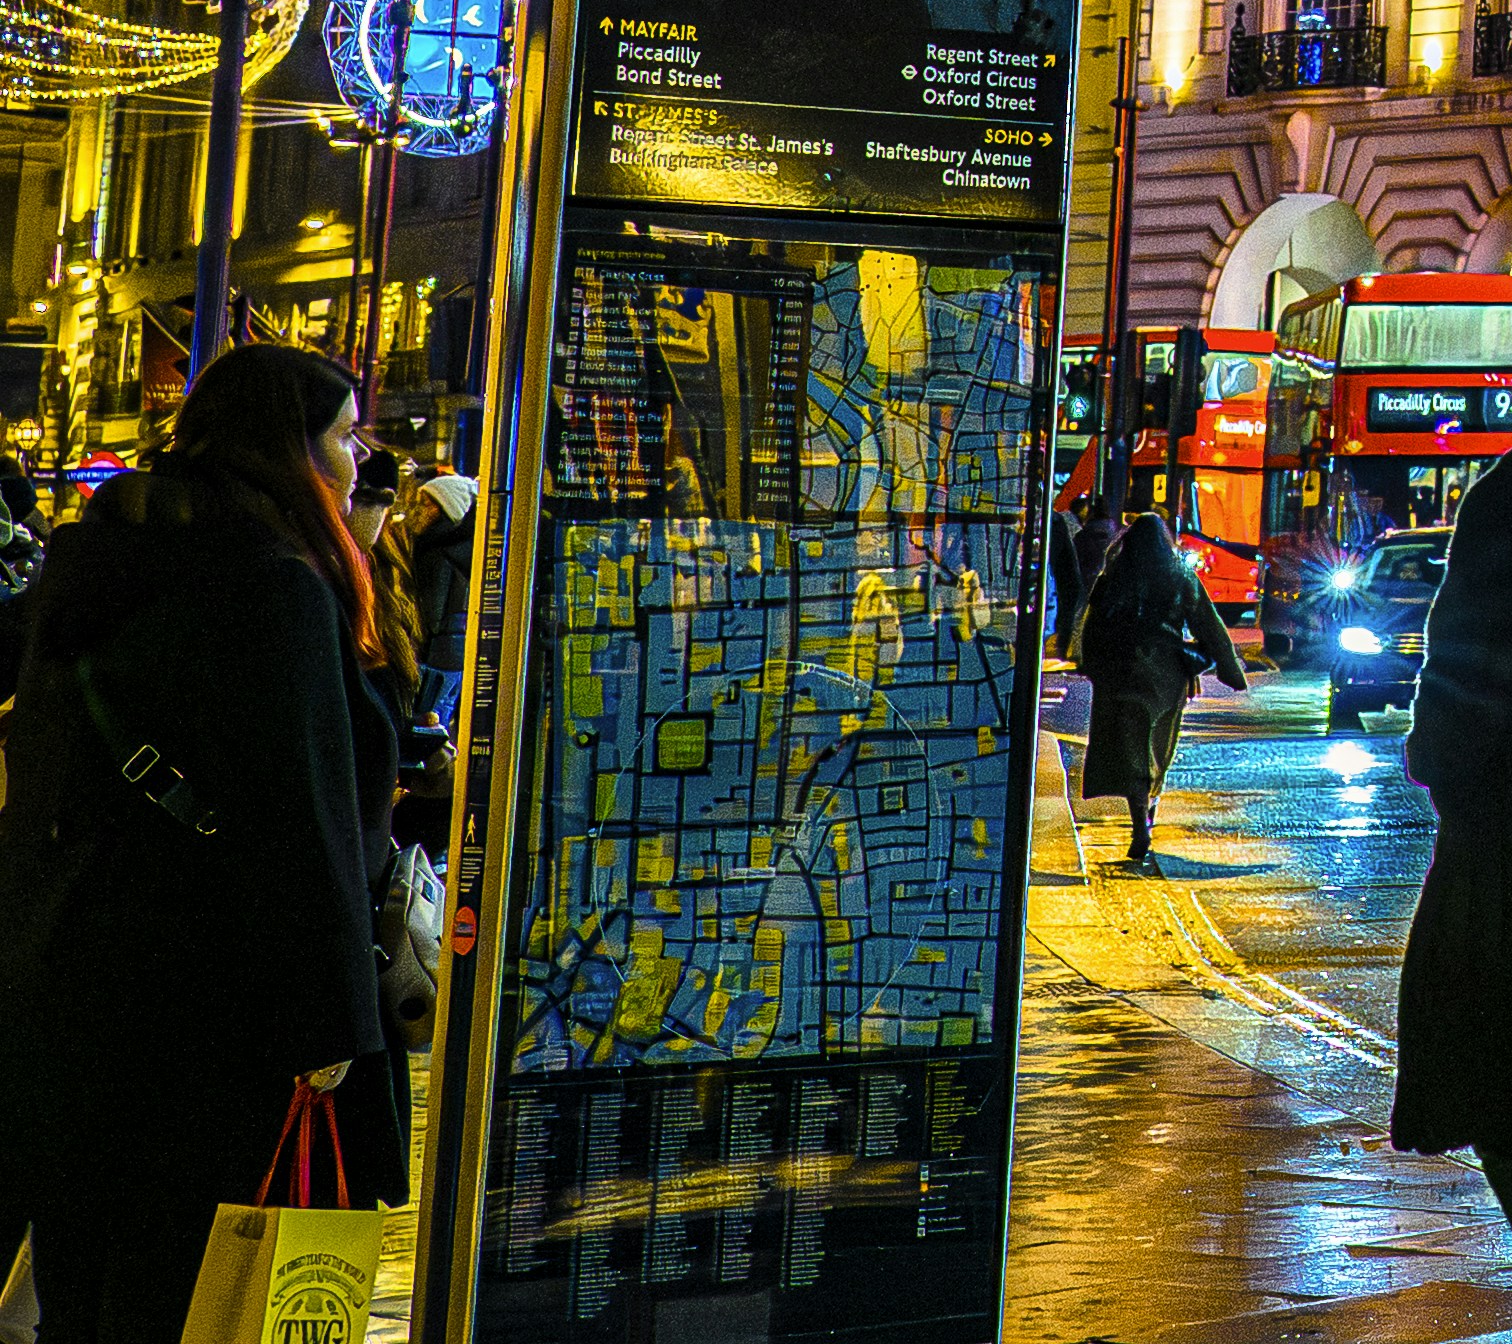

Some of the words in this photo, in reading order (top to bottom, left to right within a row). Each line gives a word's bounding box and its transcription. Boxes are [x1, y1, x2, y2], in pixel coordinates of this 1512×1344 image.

[620, 19, 698, 41] MAYFAIR
[618, 42, 701, 68] Piccadilly
[926, 44, 984, 65] Regent
[989, 49, 1038, 68] Street
[617, 65, 662, 84] Bond
[667, 69, 722, 89] Street
[923, 66, 981, 86] Oxford
[987, 72, 1037, 90] Circus
[923, 88, 980, 108] Oxford
[986, 93, 1036, 112] Street
[611, 124, 674, 146] Regent
[680, 130, 734, 150] Street
[738, 133, 761, 151] St.
[767, 135, 834, 156] James's
[984, 128, 1034, 146] SOHO
[610, 148, 716, 172] Buckingham
[723, 155, 778, 175] Palace
[866, 141, 966, 167] Shaftesbury
[971, 149, 1032, 168] Avenue
[942, 169, 1030, 190] Chinatown
[1378, 392, 1432, 416] Piccadilly
[1432, 392, 1467, 412] Circus
[277, 1319, 344, 1344] TWG
